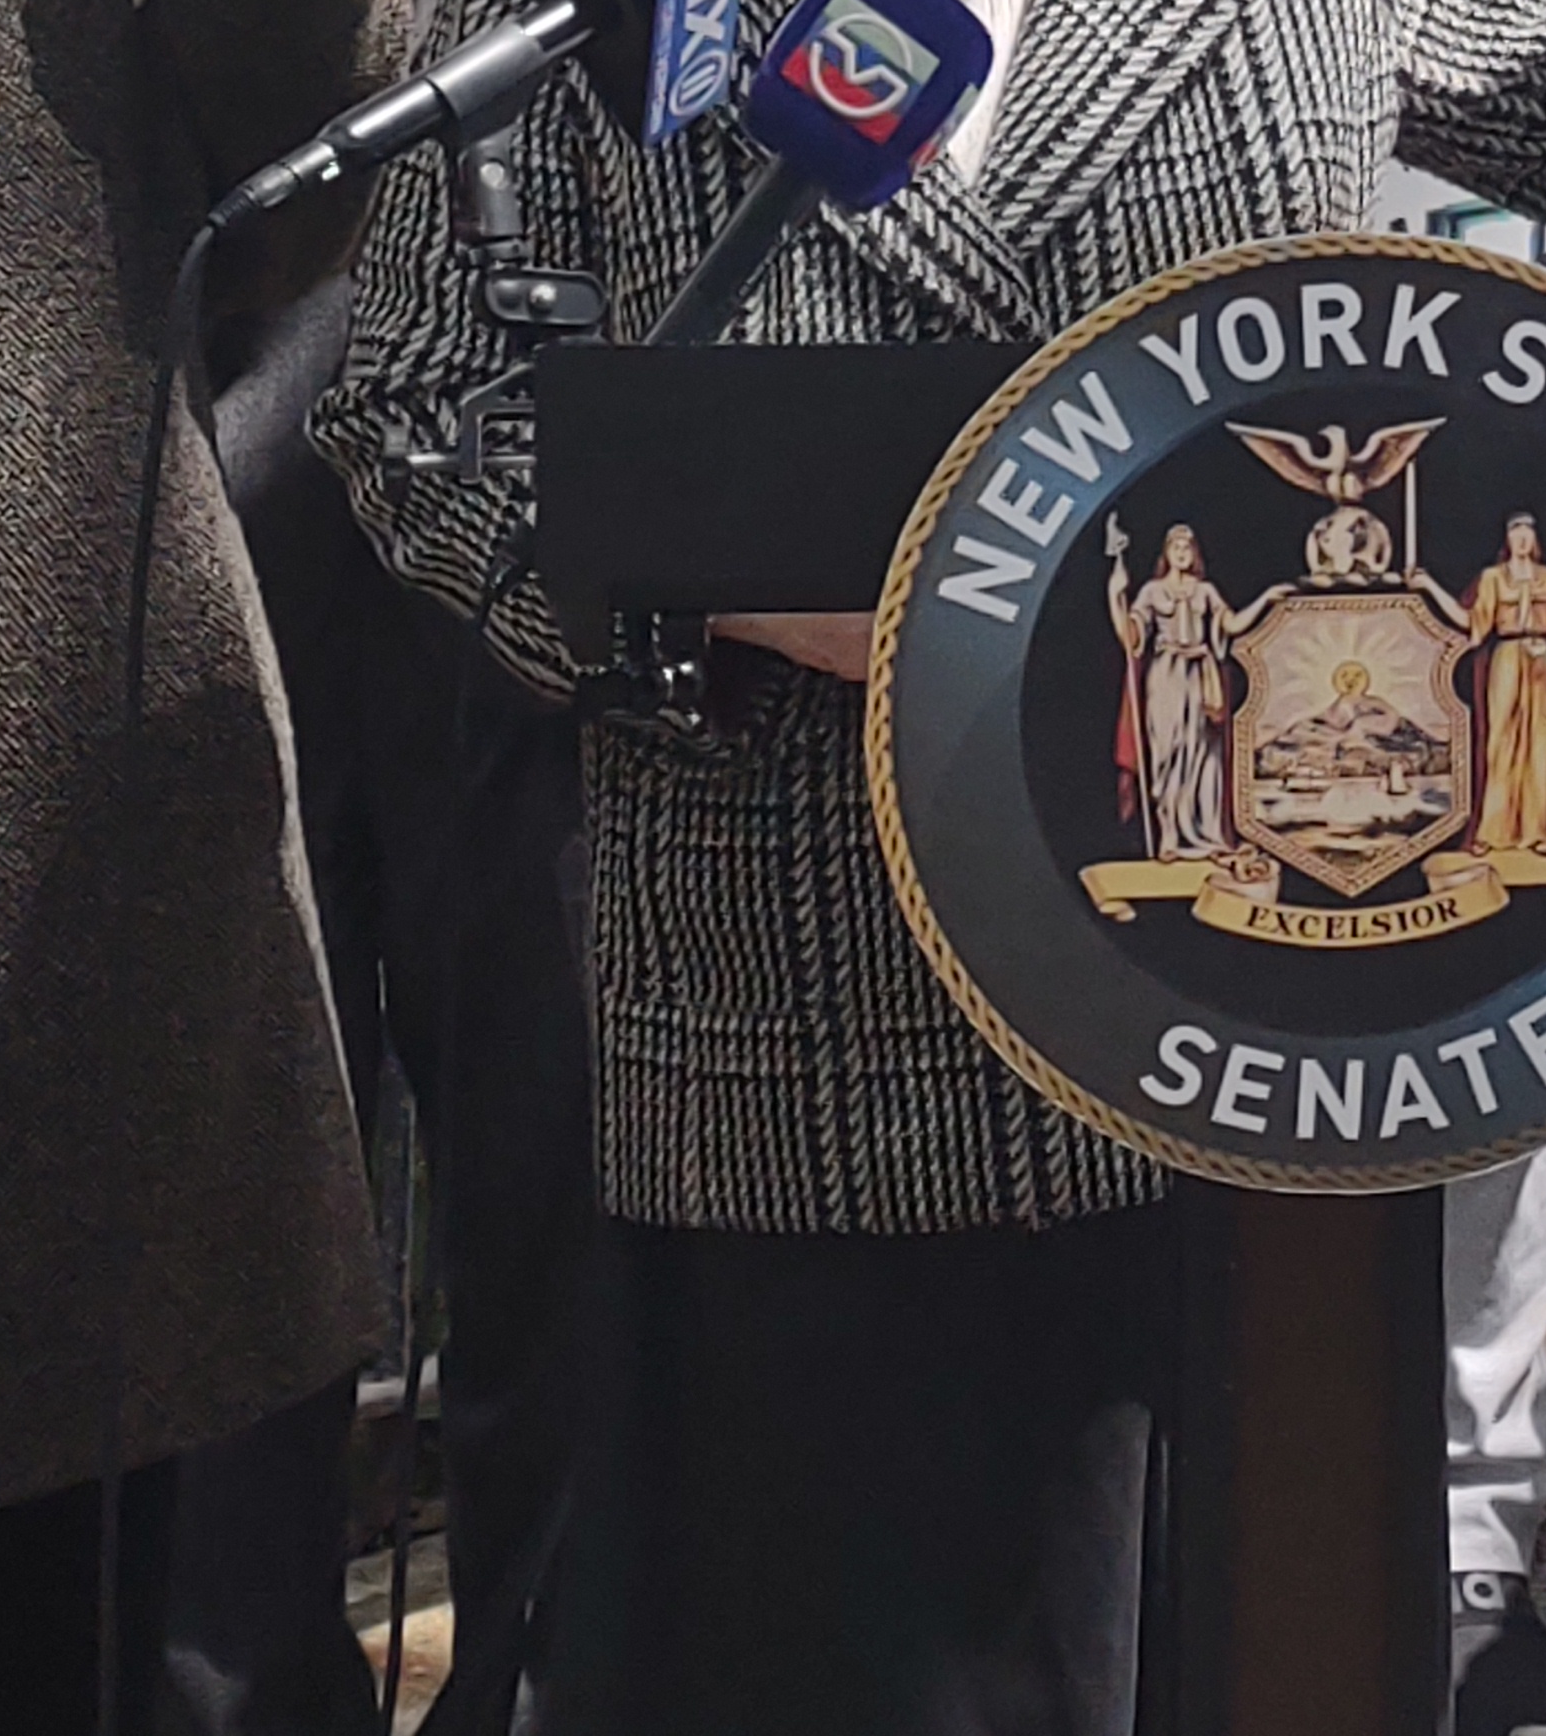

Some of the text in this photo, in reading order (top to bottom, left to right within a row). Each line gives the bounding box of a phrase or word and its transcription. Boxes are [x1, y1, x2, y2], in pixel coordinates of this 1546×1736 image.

[937, 370, 1135, 623] NEW
[1139, 281, 1463, 406] YORK
[1245, 898, 1461, 940] EXCELSIOR
